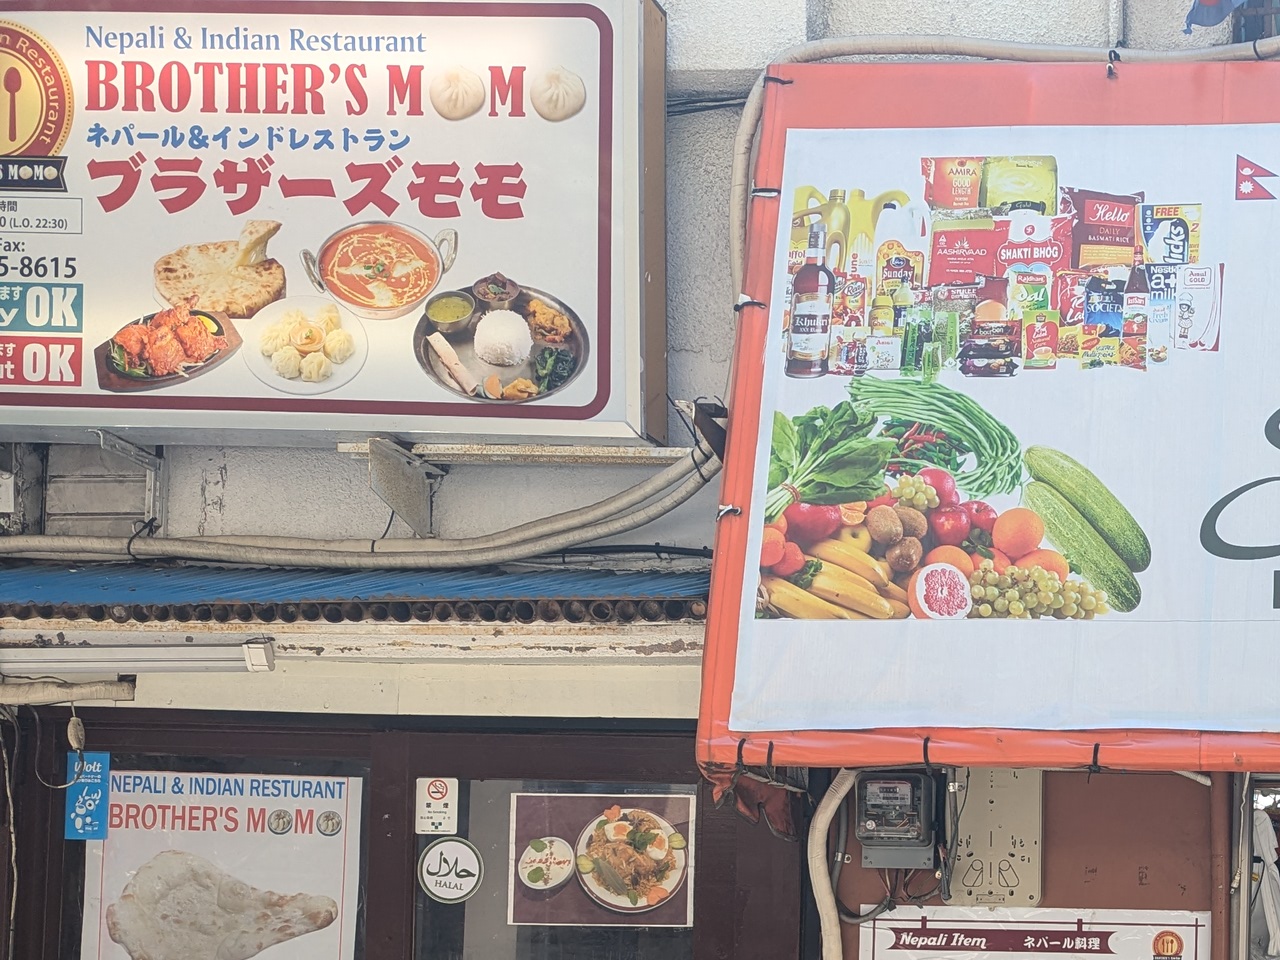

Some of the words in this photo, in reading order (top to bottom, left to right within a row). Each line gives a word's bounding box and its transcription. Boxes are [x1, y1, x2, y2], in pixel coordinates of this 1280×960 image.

[85, 26, 165, 53] Nepali
[173, 29, 194, 50] &
[200, 28, 280, 51] Indian
[290, 29, 427, 53] Restaurant
[16, 38, 59, 145] Restaurant
[85, 60, 368, 116] BROTHER'S
[948, 167, 977, 176] AMIRA
[87, 153, 527, 219] ブラザーズモモ
[1089, 203, 1130, 222] Hello
[1155, 207, 1179, 216] FREE
[35, 218, 68, 231] 22:30)
[1099, 227, 1121, 235] DAILY
[1001, 247, 1031, 260] SHAKTI
[1034, 246, 1058, 258] BHOG
[883, 268, 914, 280] Sunday
[26, 286, 78, 327] OK
[23, 343, 75, 382] OK
[111, 775, 166, 794] NEPALI
[171, 777, 184, 794] &
[189, 777, 244, 796] INDIAN
[250, 779, 345, 799] RESTURANT
[109, 804, 239, 832] BROTHER'S
[426, 851, 476, 878] حلال
[434, 880, 464, 891] HALAL
[900, 932, 948, 948] Nepali
[951, 933, 986, 949] Item
[1023, 935, 1100, 950] ネパール料理
